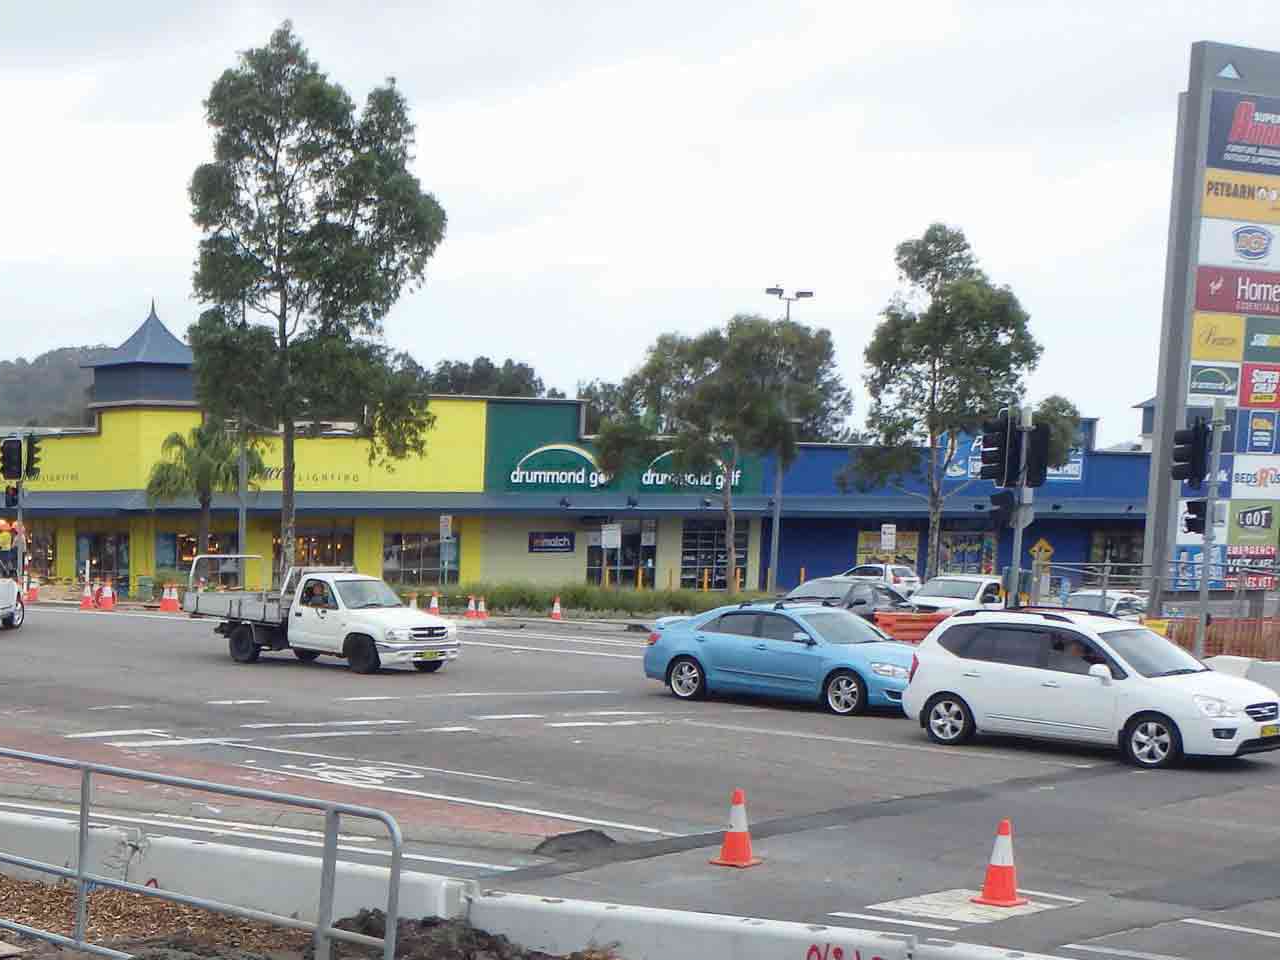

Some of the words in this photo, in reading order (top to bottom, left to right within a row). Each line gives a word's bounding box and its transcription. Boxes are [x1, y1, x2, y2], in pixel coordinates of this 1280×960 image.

[1206, 181, 1255, 200] PETBARN
[511, 466, 585, 484] drummond
[589, 472, 614, 488] go
[715, 470, 741, 490] glf
[1234, 472, 1257, 485] BEDS
[1239, 511, 1271, 527] LOOT
